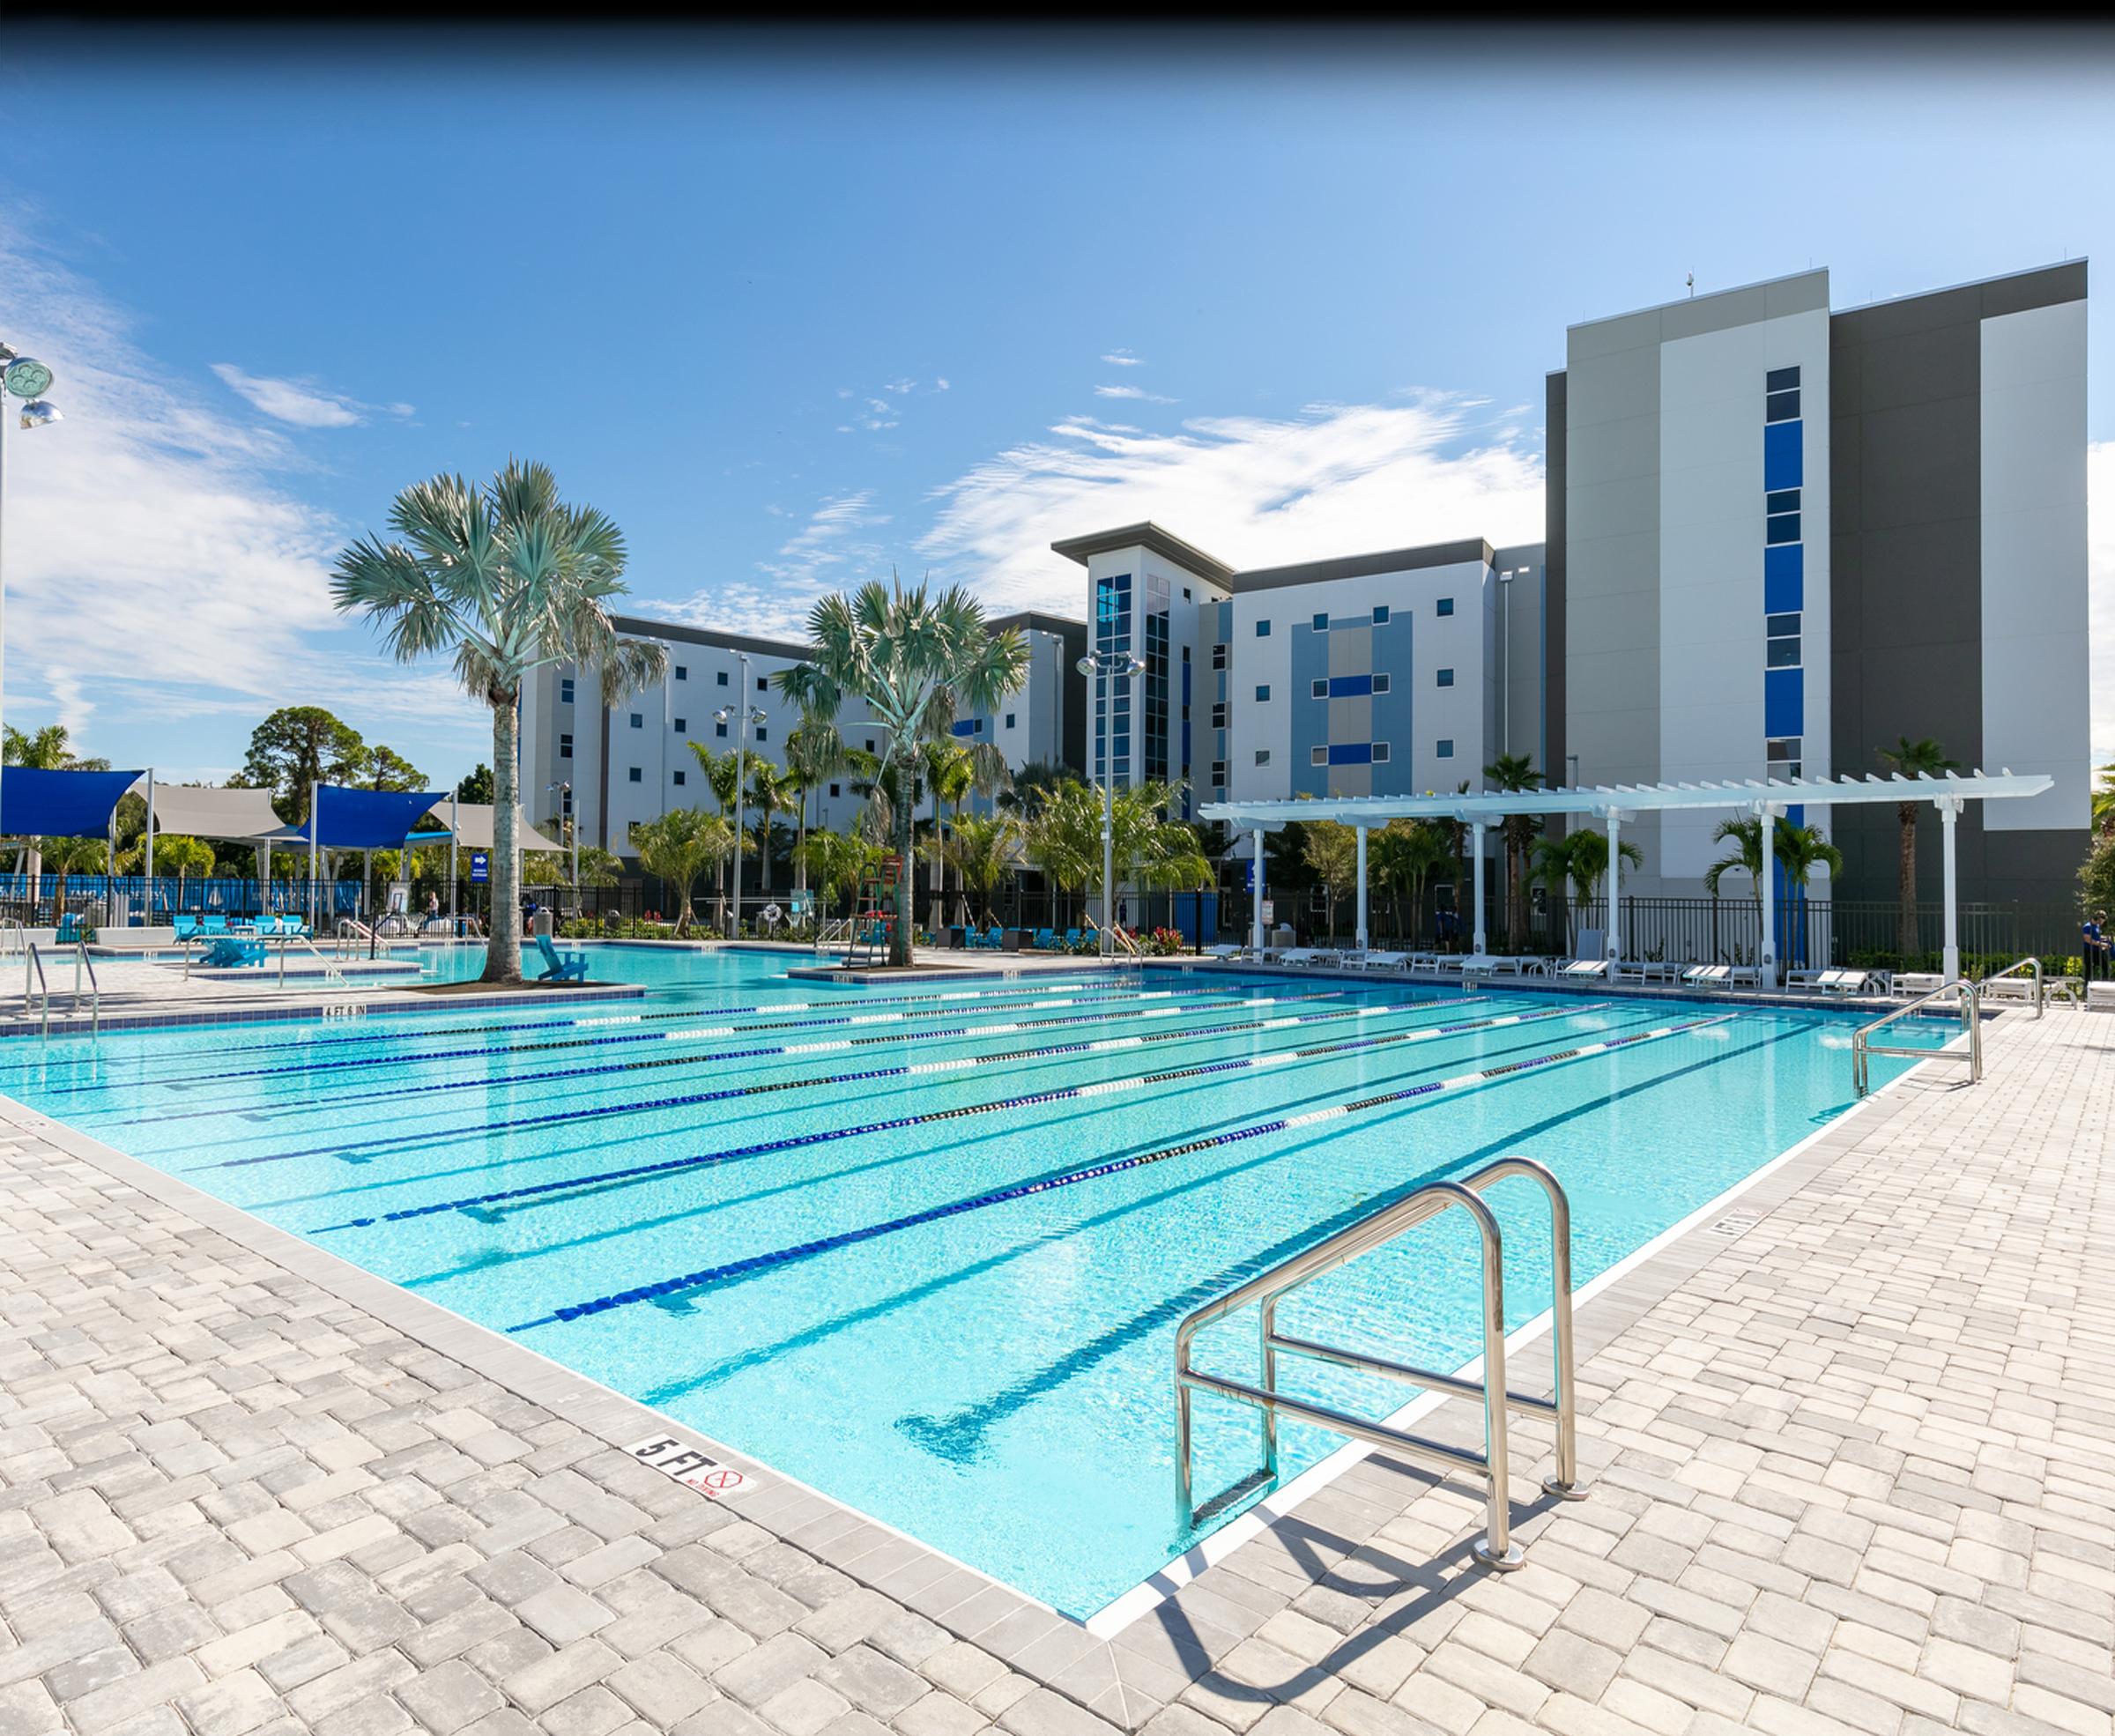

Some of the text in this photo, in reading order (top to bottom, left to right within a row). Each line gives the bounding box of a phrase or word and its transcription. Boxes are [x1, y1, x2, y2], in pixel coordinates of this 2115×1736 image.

[335, 1005, 345, 1016] FT
[635, 1439, 718, 1476] 5 FT
